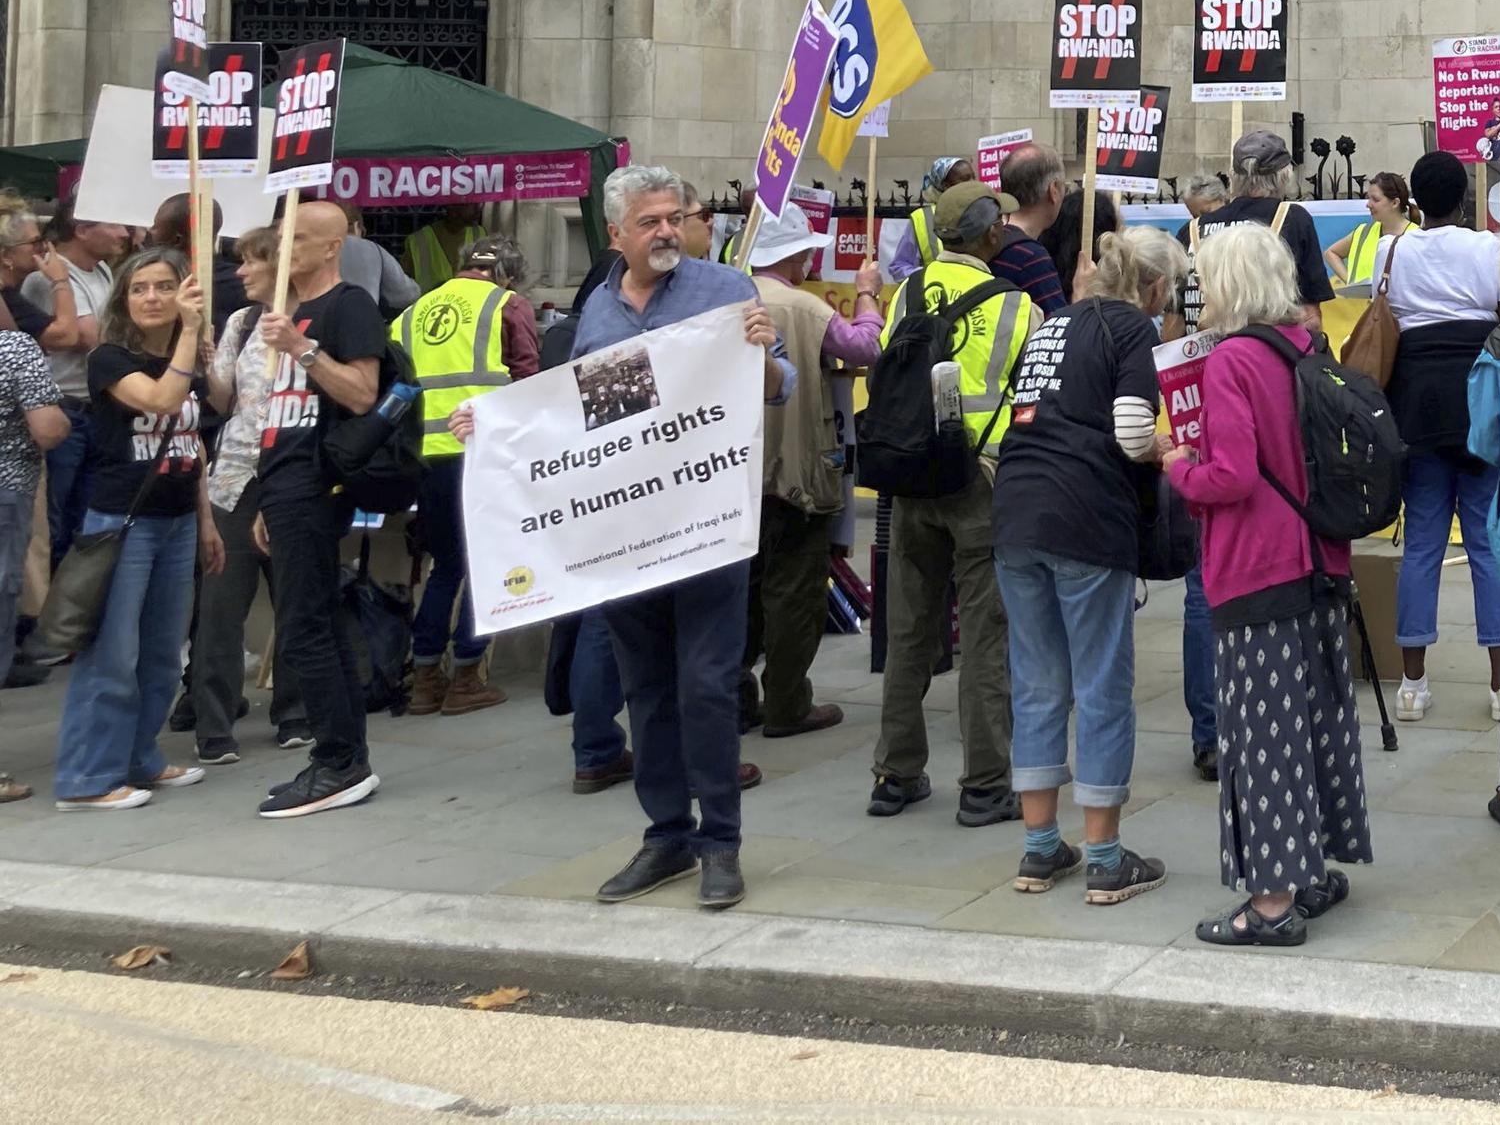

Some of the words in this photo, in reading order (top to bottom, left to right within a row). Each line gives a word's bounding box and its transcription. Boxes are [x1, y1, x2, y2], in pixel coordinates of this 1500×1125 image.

[1059, 4, 1137, 38] STOP
[1058, 38, 1135, 59] RWANDA
[1201, 30, 1281, 51] RWANDA
[1477, 45, 1500, 53] RACISM
[162, 71, 253, 105] SOP
[1438, 71, 1454, 83] No
[1457, 71, 1469, 81] to
[279, 70, 335, 114] STOP
[1099, 106, 1163, 134] STOP
[1440, 101, 1466, 115] Stop
[1469, 100, 1489, 112] the
[276, 107, 332, 137] RWANDA
[1440, 117, 1478, 131] flights
[981, 149, 998, 164] End
[1096, 132, 1158, 153] RWANDA
[369, 163, 504, 198] RACISM
[982, 163, 999, 177] raci
[838, 244, 876, 254] CALAS
[969, 307, 986, 336] CISM
[1201, 343, 1212, 354] TO
[268, 395, 319, 427] NDA
[1171, 383, 1201, 416] All
[530, 436, 633, 482] Refugee
[641, 403, 726, 446] rights
[520, 507, 564, 534] are
[570, 476, 664, 519] human
[672, 446, 751, 485] rights
[565, 545, 626, 573] International
[628, 529, 682, 553] Federation
[685, 524, 695, 535] of
[696, 515, 720, 531] Iraqi
